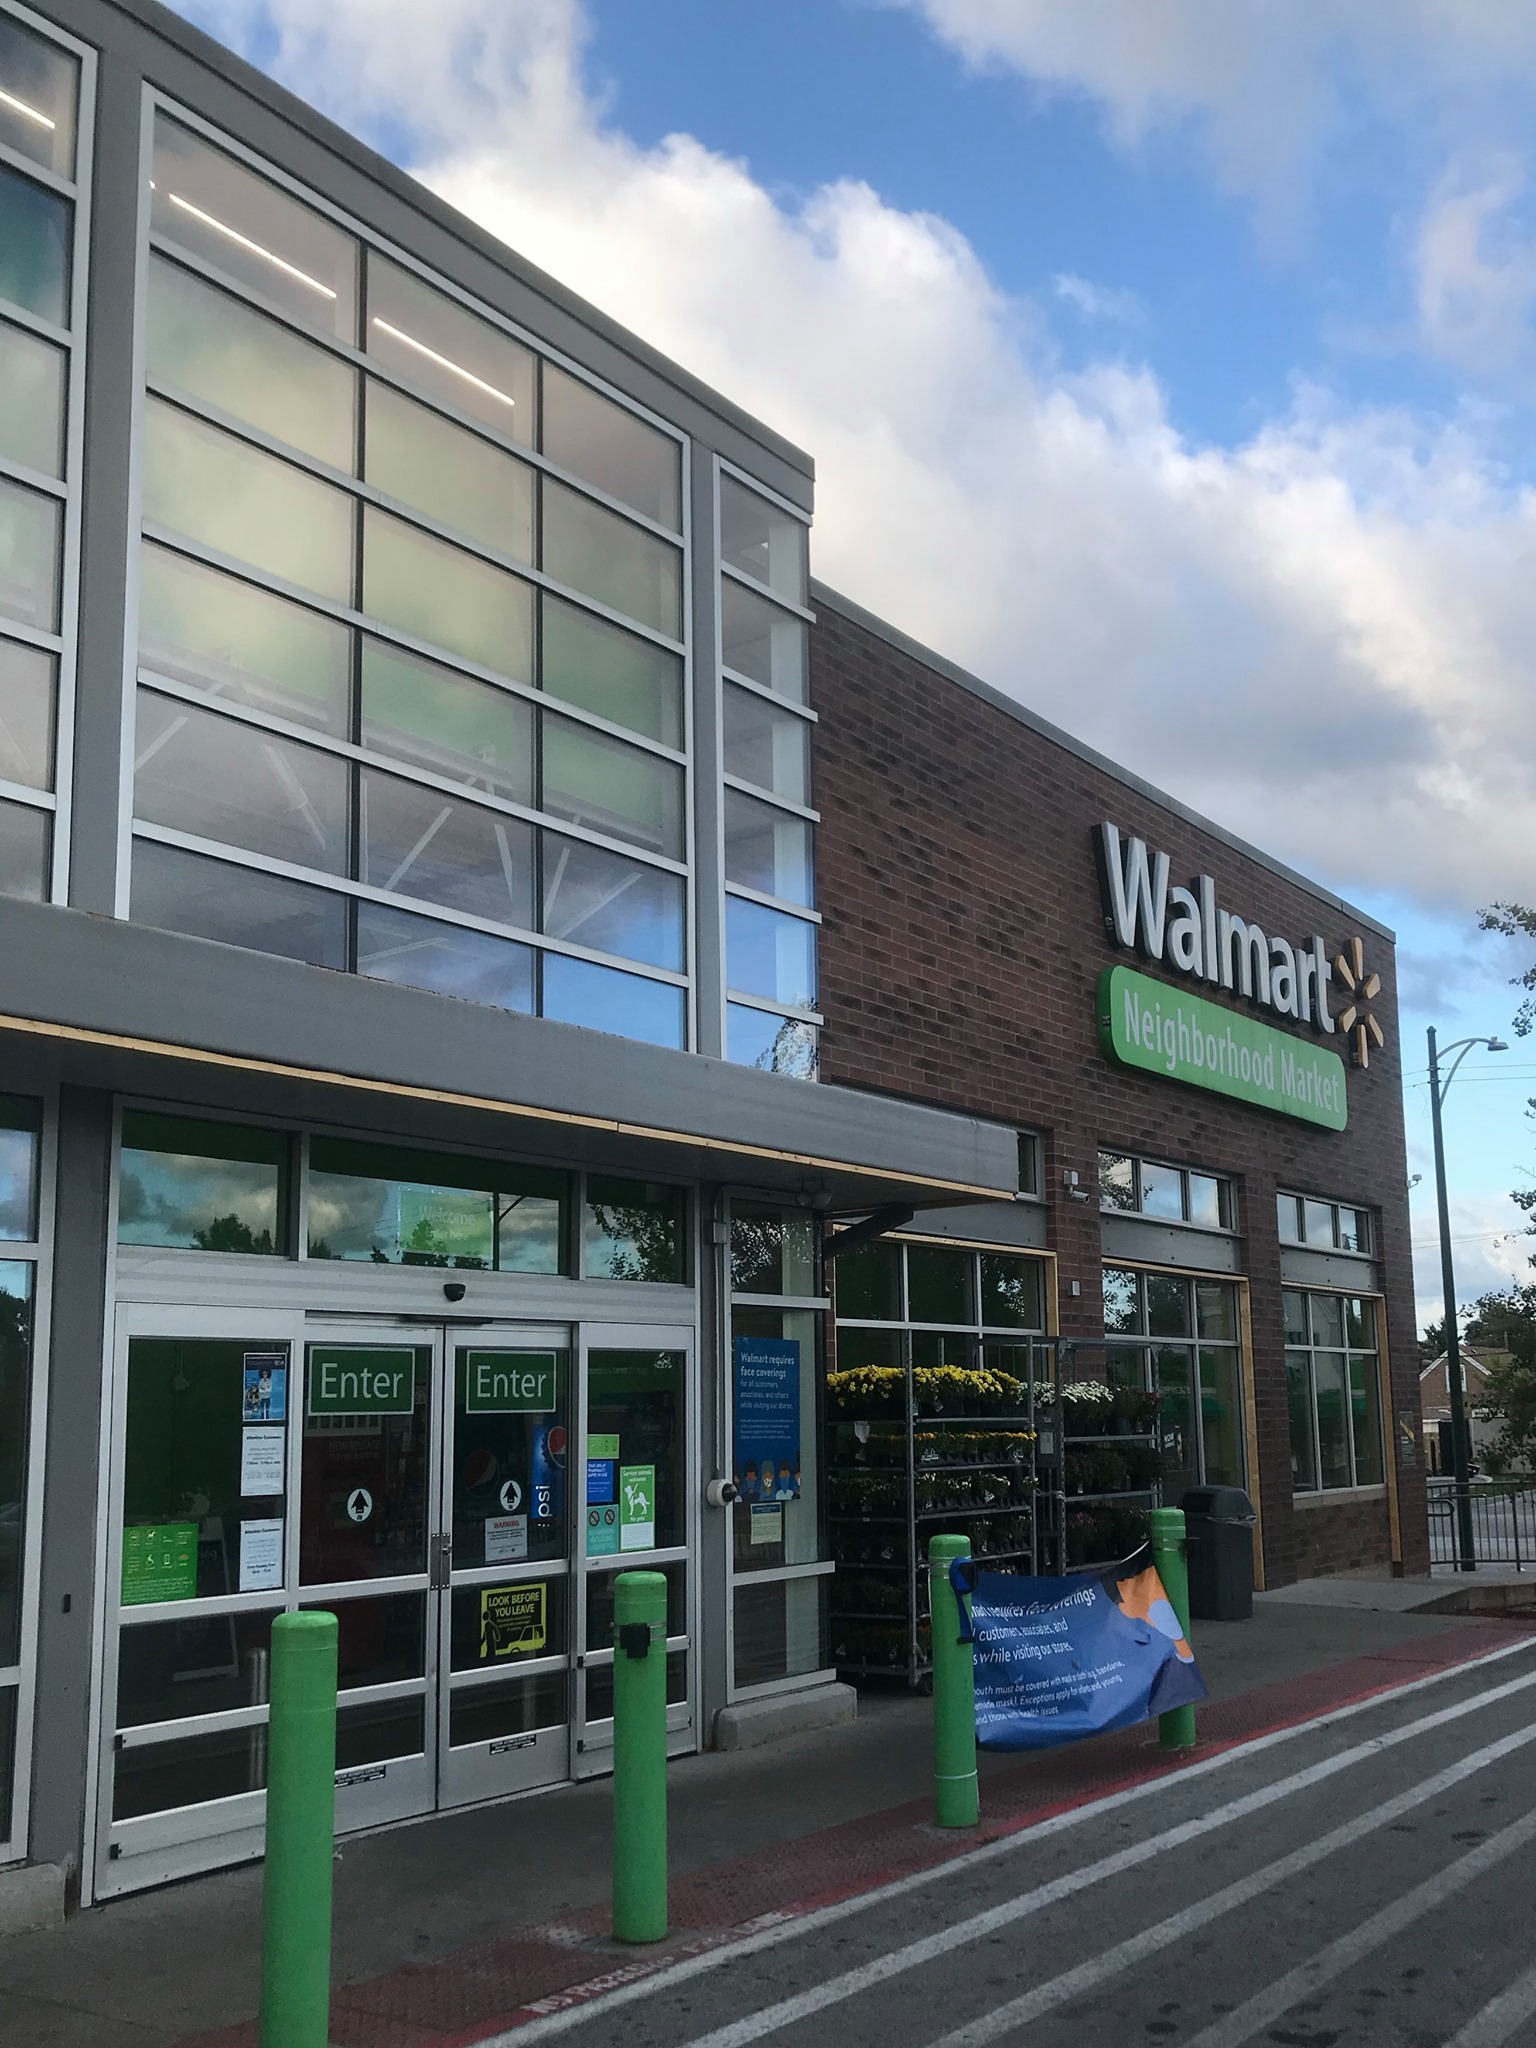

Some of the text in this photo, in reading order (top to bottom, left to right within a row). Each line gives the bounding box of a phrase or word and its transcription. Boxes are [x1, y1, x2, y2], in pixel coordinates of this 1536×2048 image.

[1100, 821, 1334, 1034] Walmart
[1123, 988, 1340, 1113] Neighborhood Market
[419, 1205, 476, 1226] Welcome
[740, 1352, 795, 1367] Walmart requires
[321, 1362, 404, 1399] Enter
[476, 1364, 547, 1399] Enter
[741, 1366, 787, 1380] face coverings
[535, 1485, 553, 1518] psi
[494, 1520, 519, 1529] WARNING
[489, 1592, 540, 1607] LOOK BEFORE
[495, 1603, 535, 1618] YOU LEAVE
[1053, 1617, 1069, 1633] and
[980, 1647, 1011, 1664] while
[1013, 1642, 1041, 1661] visiting
[1040, 1644, 1052, 1655] our
[995, 1684, 1014, 1695] must
[1015, 1684, 1025, 1693] be
[1026, 1678, 1050, 1691] covered
[1019, 1693, 1055, 1706] Exceptions
[1056, 1688, 1070, 1701] apply
[1101, 1674, 1123, 1689] young
